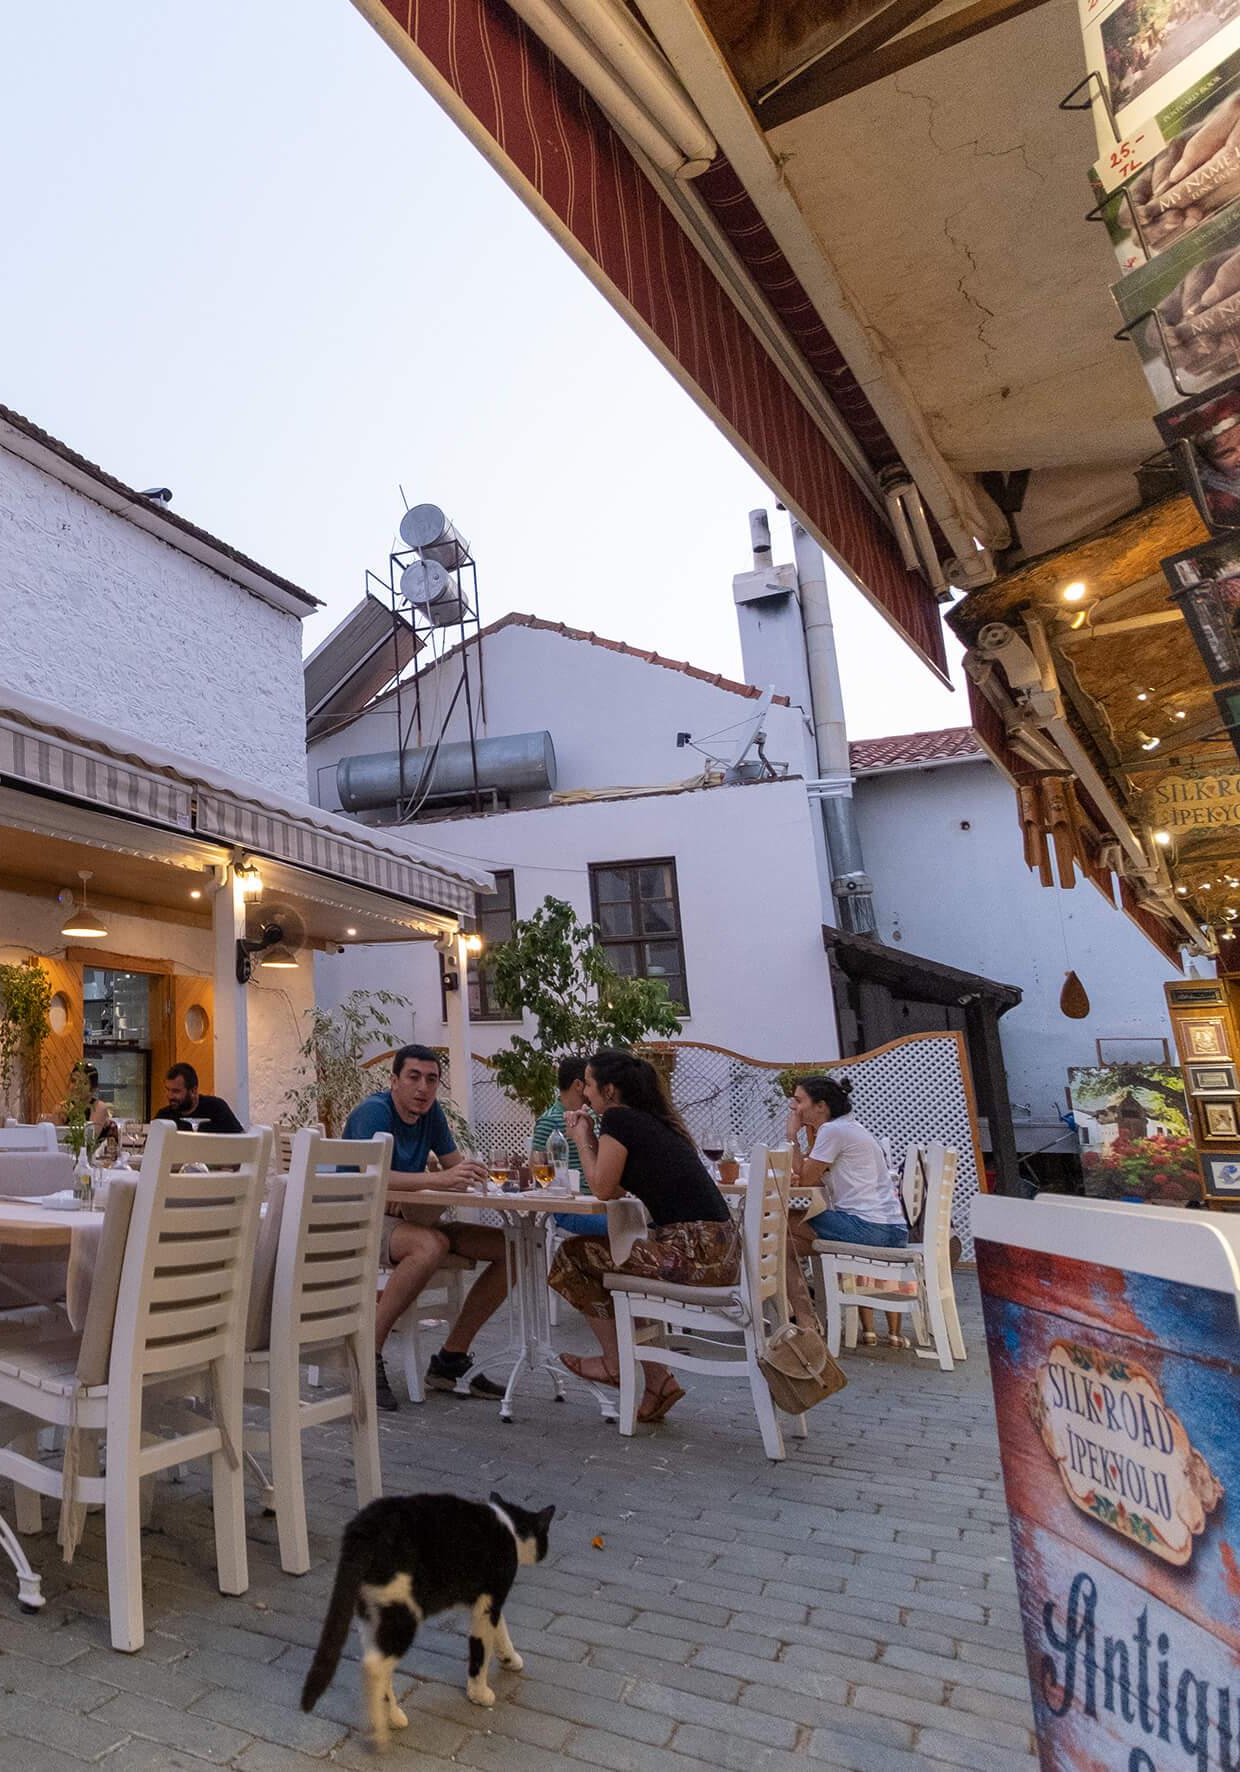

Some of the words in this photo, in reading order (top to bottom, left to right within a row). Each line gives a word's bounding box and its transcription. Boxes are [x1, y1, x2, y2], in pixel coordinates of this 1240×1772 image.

[1159, 191, 1182, 213] MY
[1185, 153, 1232, 194] NAME
[1156, 782, 1212, 805] SILK
[1048, 1363, 1102, 1425] SILK
[1100, 1382, 1174, 1455] ROAD
